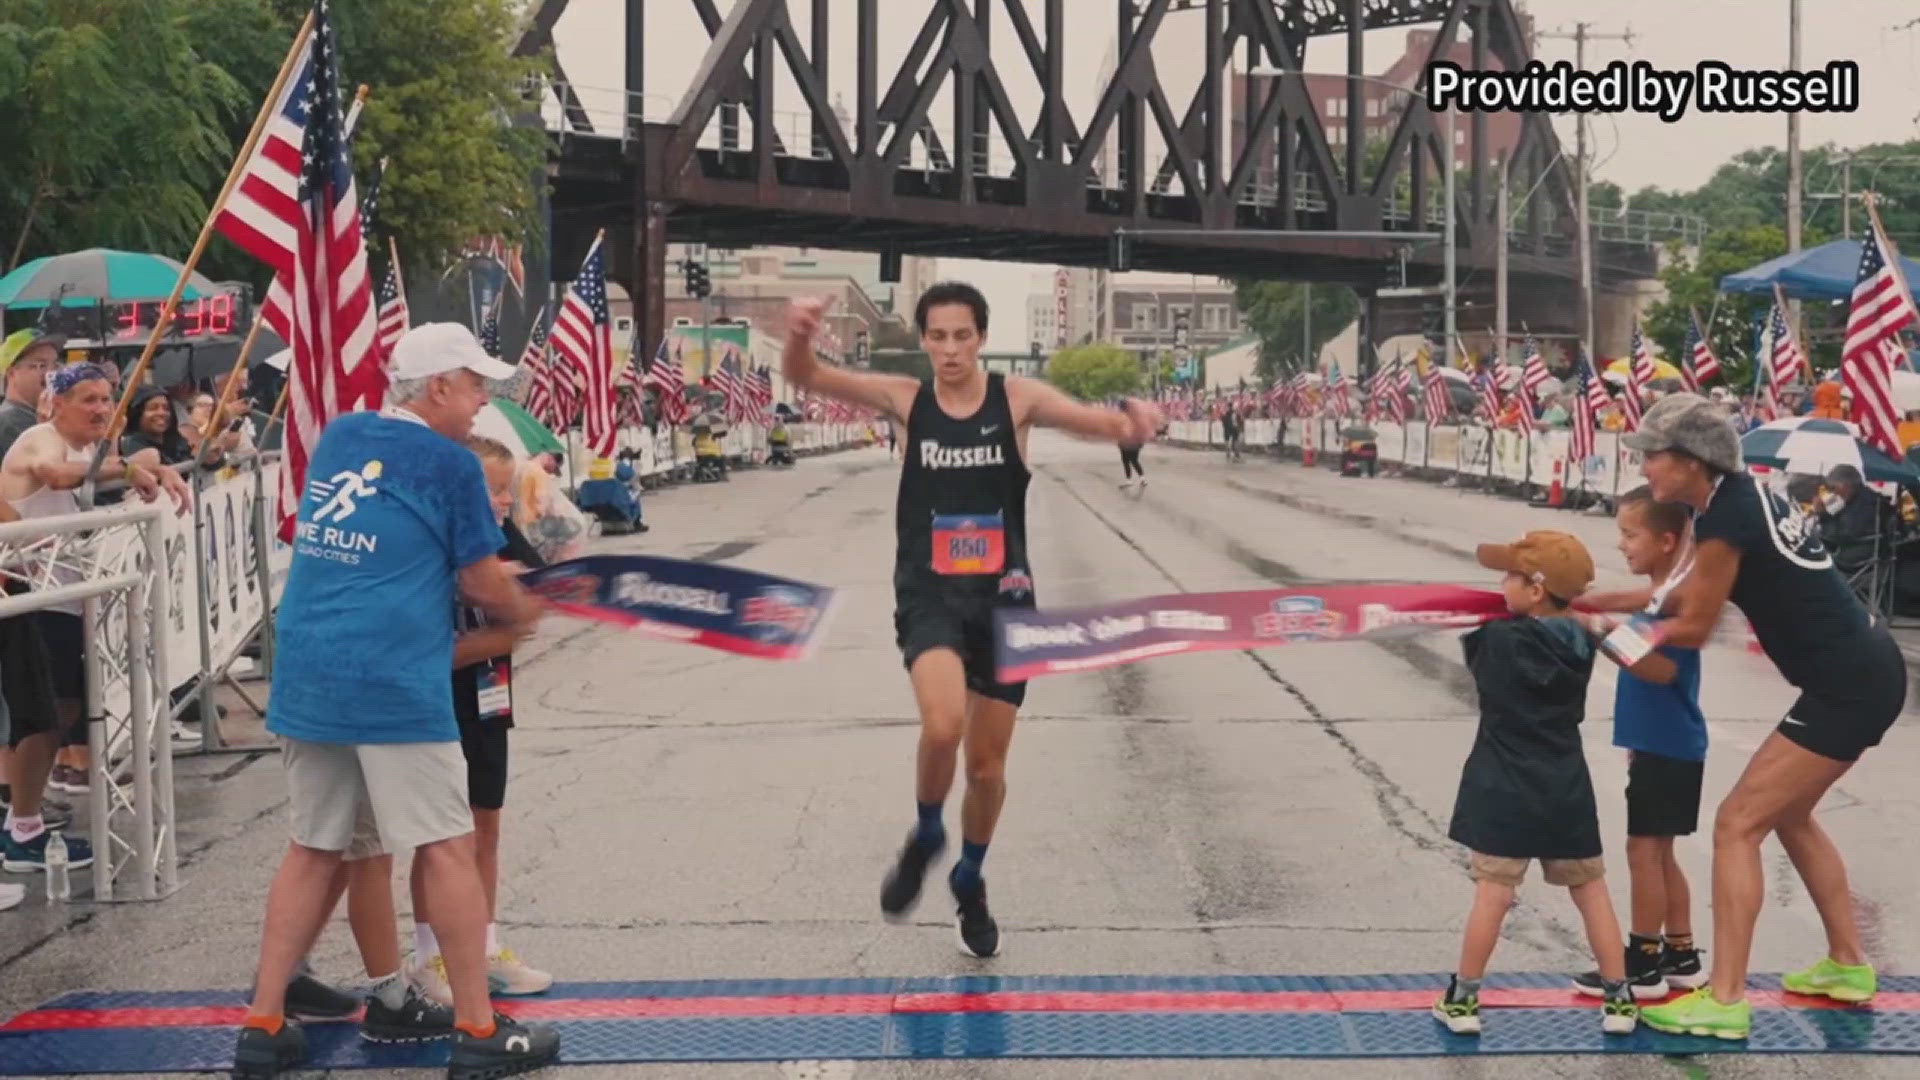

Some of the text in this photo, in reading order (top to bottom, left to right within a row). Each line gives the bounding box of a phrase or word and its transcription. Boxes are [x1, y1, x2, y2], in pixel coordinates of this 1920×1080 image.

[920, 440, 1004, 469] RUSSELL
[323, 526, 377, 553] RUN
[950, 537, 987, 558] 850
